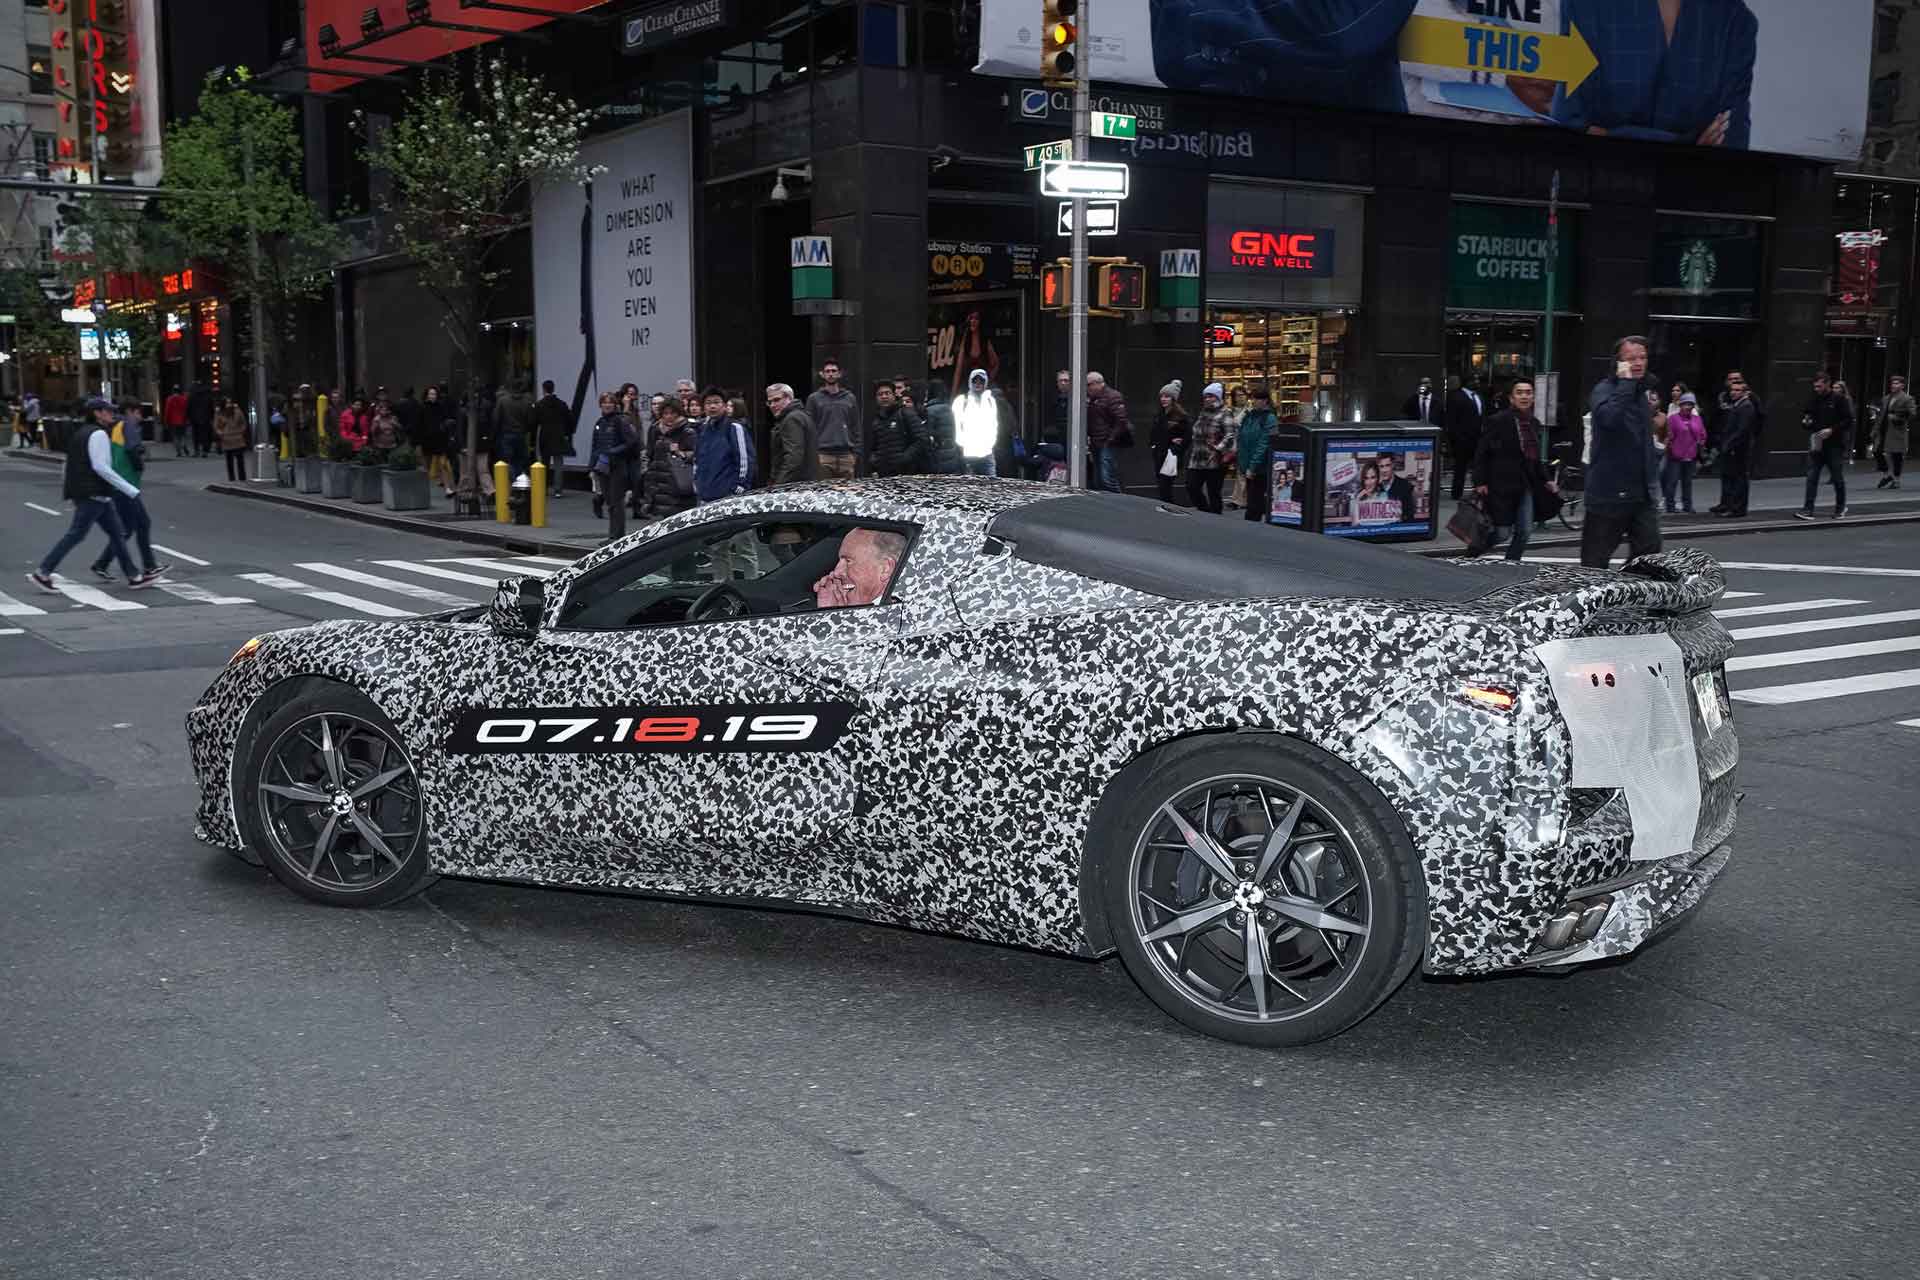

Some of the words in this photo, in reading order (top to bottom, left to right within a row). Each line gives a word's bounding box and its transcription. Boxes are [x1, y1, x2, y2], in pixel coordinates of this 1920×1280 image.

[1464, 27, 1540, 73] THIS
[1050, 91, 1164, 120] CLRCHANNEL
[1106, 116, 1117, 136] 7
[1025, 149, 1036, 169] W
[1038, 149, 1053, 163] 49
[1054, 144, 1063, 155] ST
[621, 174, 656, 200] WHAT
[606, 202, 672, 232] DIMENSION
[627, 236, 652, 258] ARE
[928, 240, 956, 255] ubway
[959, 243, 992, 254] Station
[1231, 231, 1315, 257] GNC
[1231, 255, 1265, 266] LIVE
[1273, 257, 1313, 269] WELL
[1477, 257, 1540, 280] COFFEE
[627, 266, 652, 287] YOU
[625, 296, 656, 319] EVEN
[631, 328, 650, 347] IN?
[476, 715, 818, 743] 07.18.19
